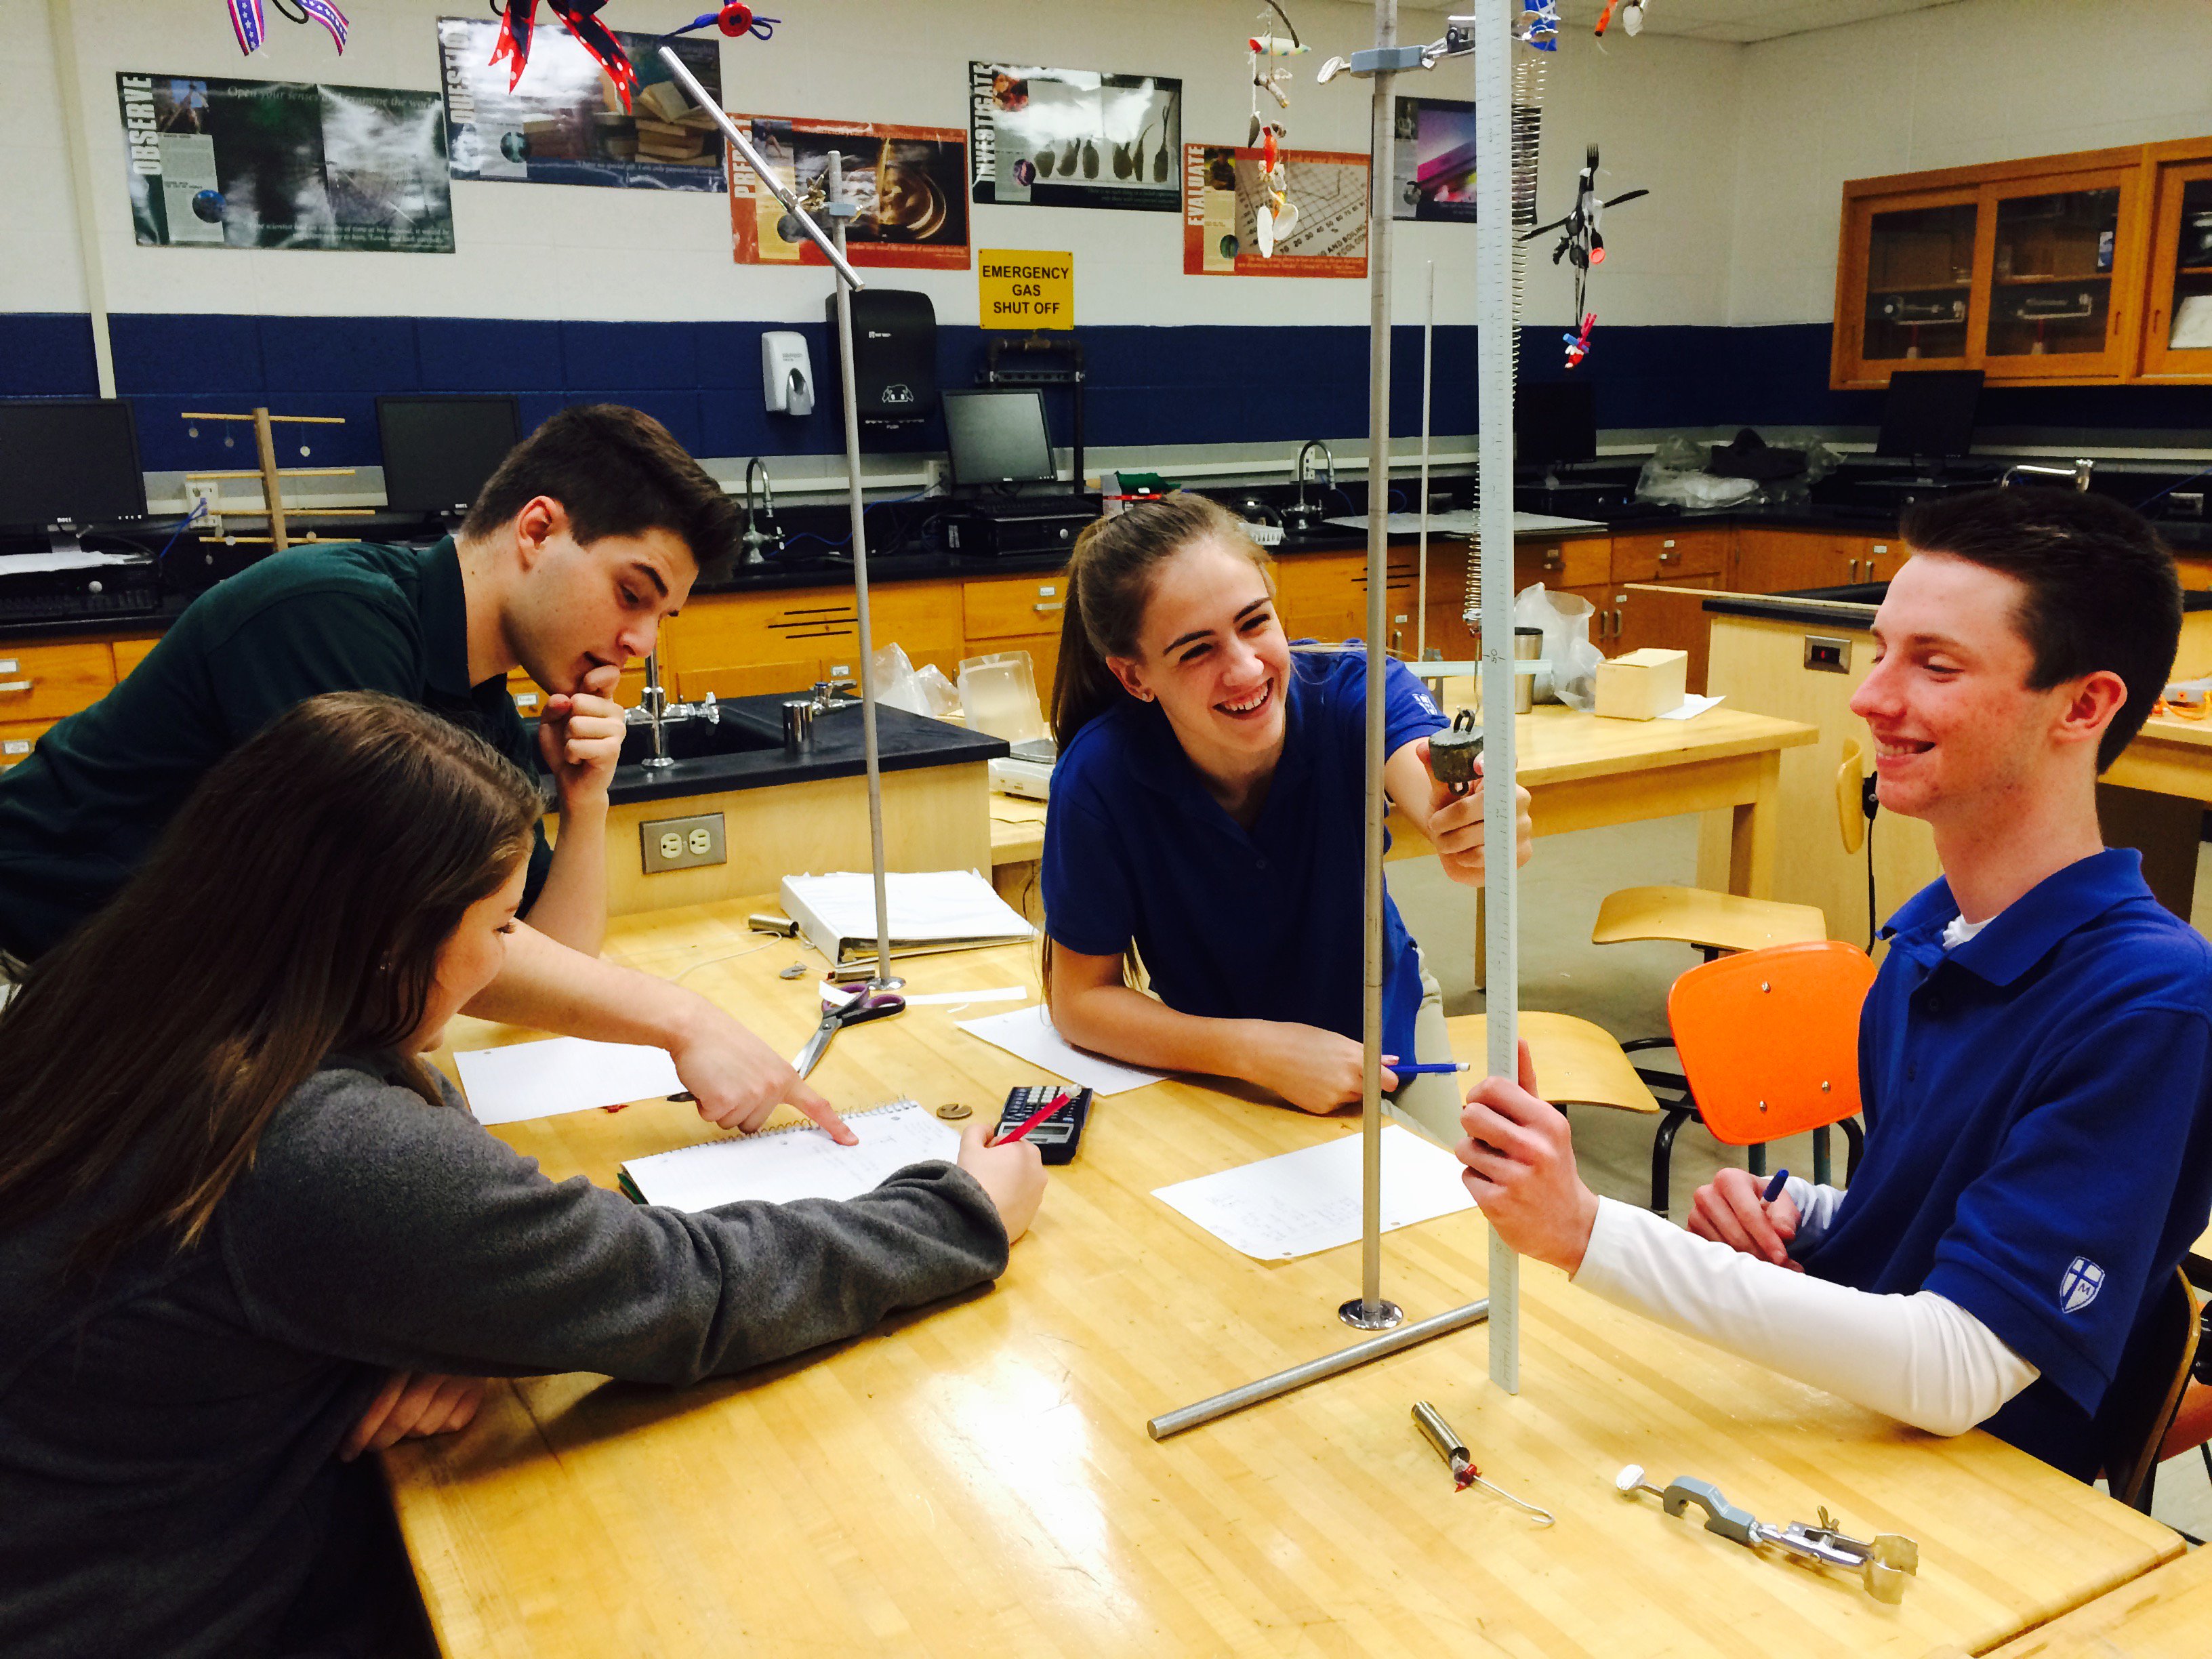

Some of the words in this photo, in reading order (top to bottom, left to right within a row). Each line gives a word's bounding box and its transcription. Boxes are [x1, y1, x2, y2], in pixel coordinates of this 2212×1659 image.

[445, 21, 475, 123] QUESTIO
[123, 76, 162, 175] OBSERVE
[973, 63, 996, 182] INVESTIGATE
[1187, 146, 1205, 226] EVALUATE
[1293, 238, 1303, 247] 20
[982, 265, 1069, 279] EMERGENCY
[1012, 284, 1041, 297] GAS
[994, 302, 1029, 314] SHUT
[1034, 302, 1060, 314] OFF
[2078, 1283, 2091, 1296] M
